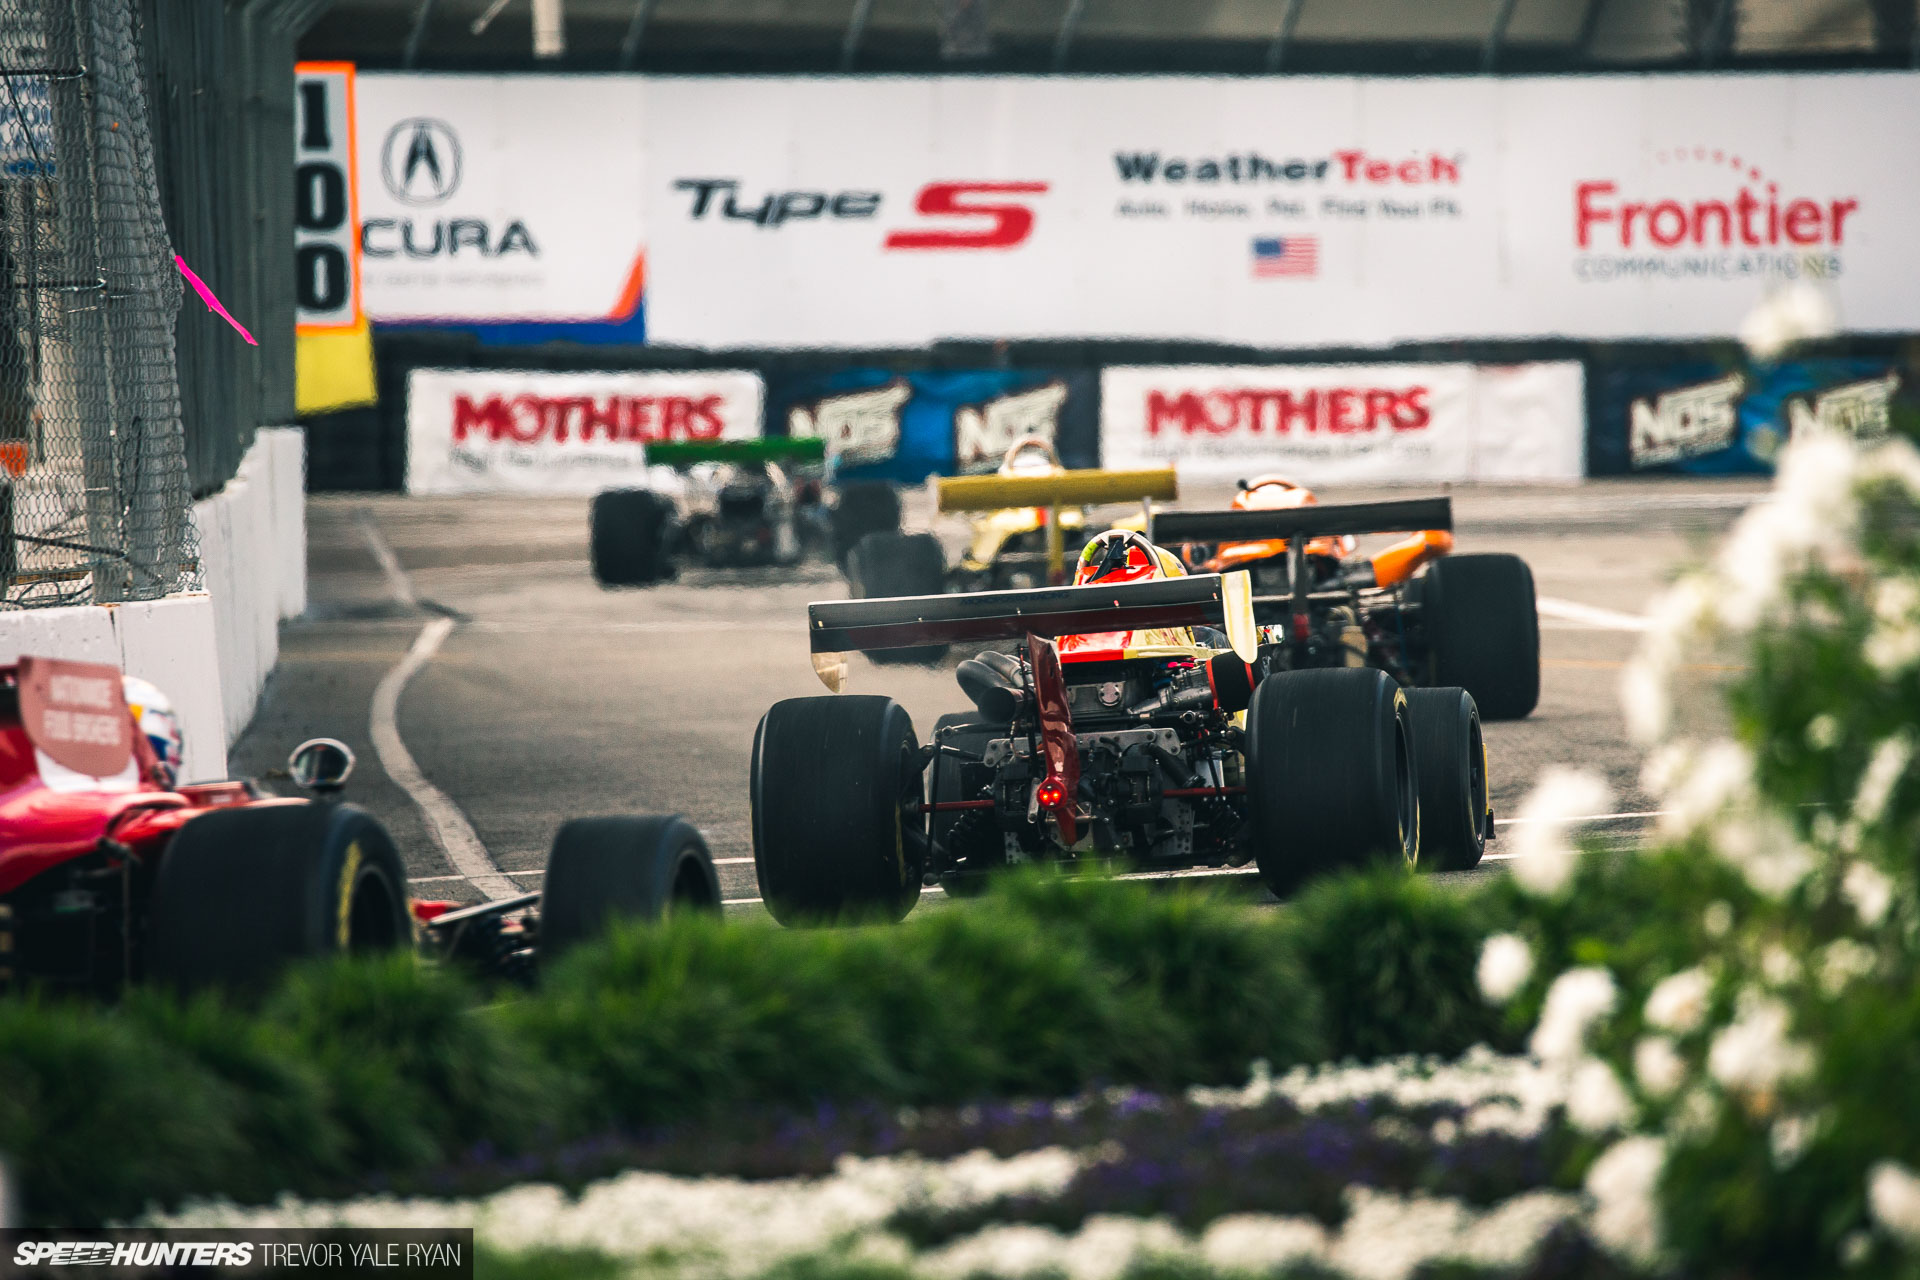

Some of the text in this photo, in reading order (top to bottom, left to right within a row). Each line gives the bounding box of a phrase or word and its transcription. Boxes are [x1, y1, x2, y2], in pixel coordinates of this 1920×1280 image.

[1114, 150, 1461, 184] WeatherTech
[361, 219, 540, 258] CURA
[673, 179, 1050, 250] Type S
[1574, 180, 1858, 247] Frontier
[453, 394, 723, 443] MOTHERS
[1145, 385, 1432, 436] MOTHERS
